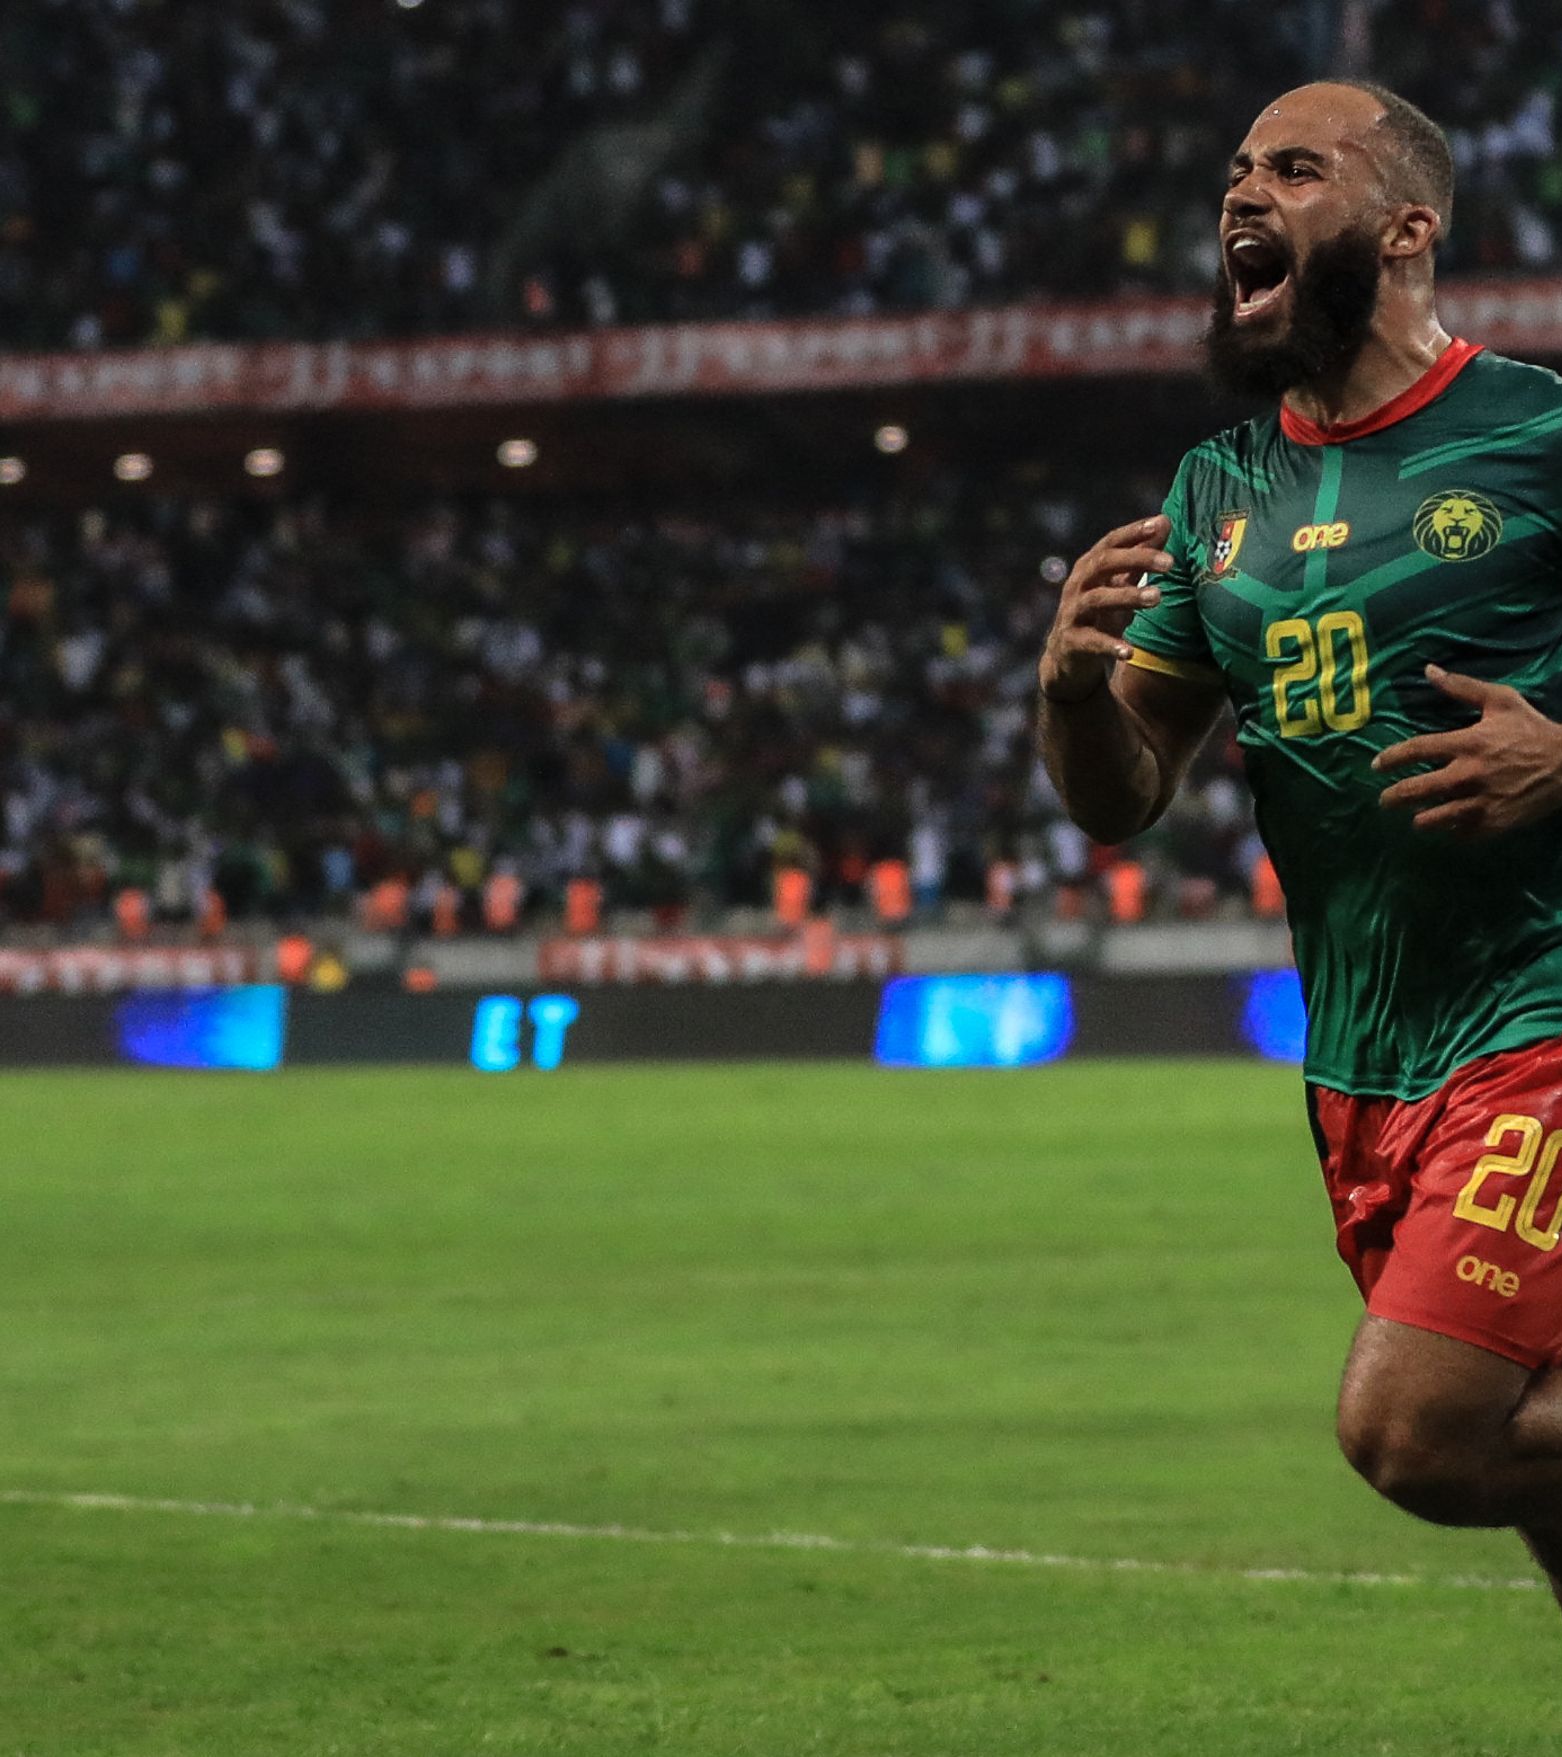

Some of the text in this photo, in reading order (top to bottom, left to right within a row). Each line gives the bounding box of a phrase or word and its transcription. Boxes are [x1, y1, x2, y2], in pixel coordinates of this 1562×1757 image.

[1293, 522, 1348, 551] one
[1266, 611, 1370, 738] 20
[1456, 1255, 1520, 1297] one
